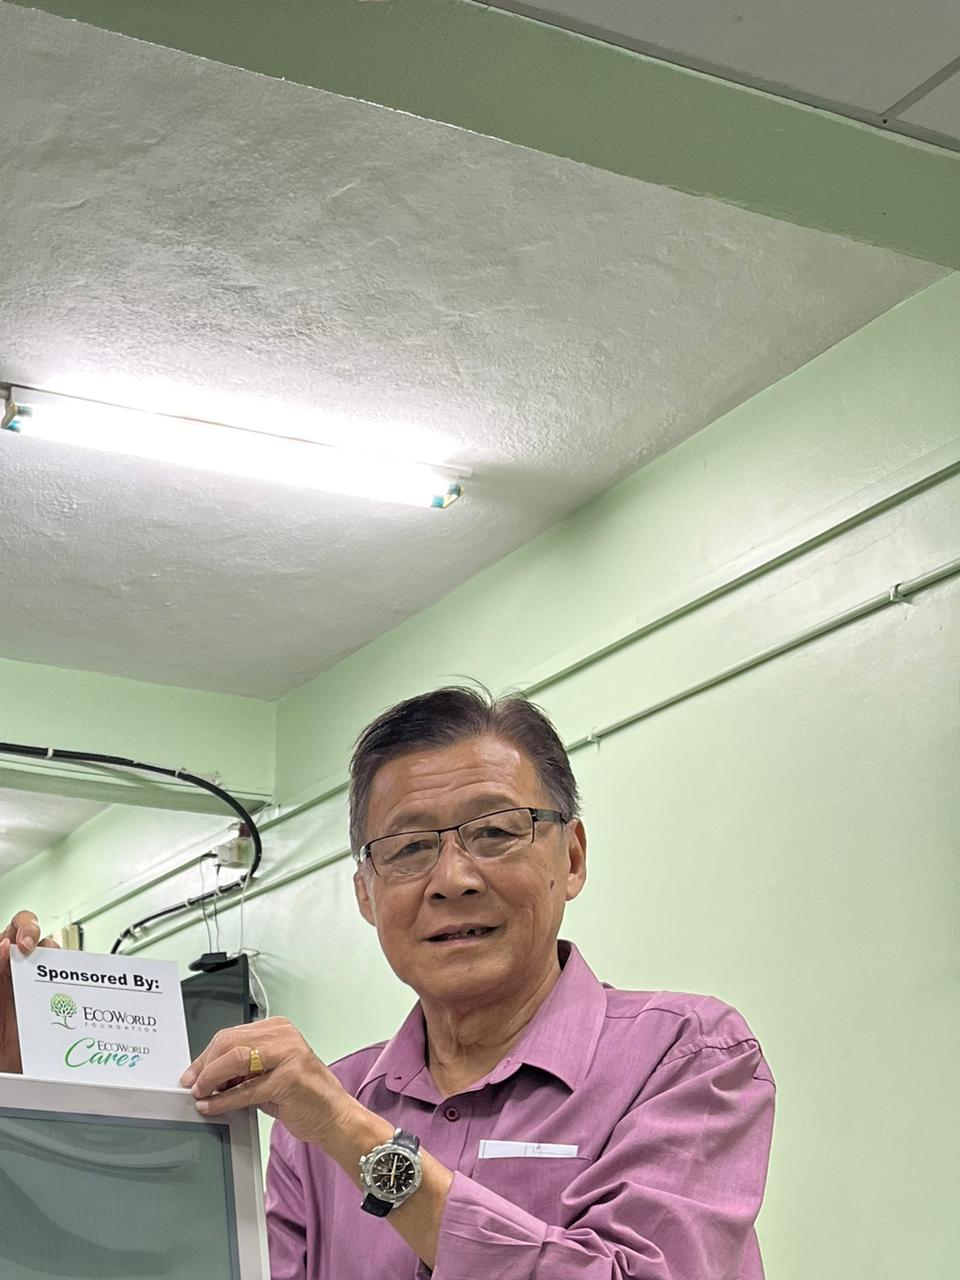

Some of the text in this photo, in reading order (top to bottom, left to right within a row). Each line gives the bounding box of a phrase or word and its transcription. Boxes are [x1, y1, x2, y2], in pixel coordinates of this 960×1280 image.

[36, 964, 160, 991] Sponsored By:
[85, 1022, 158, 1032] FOUNDATION
[64, 1037, 143, 1068] Cares
